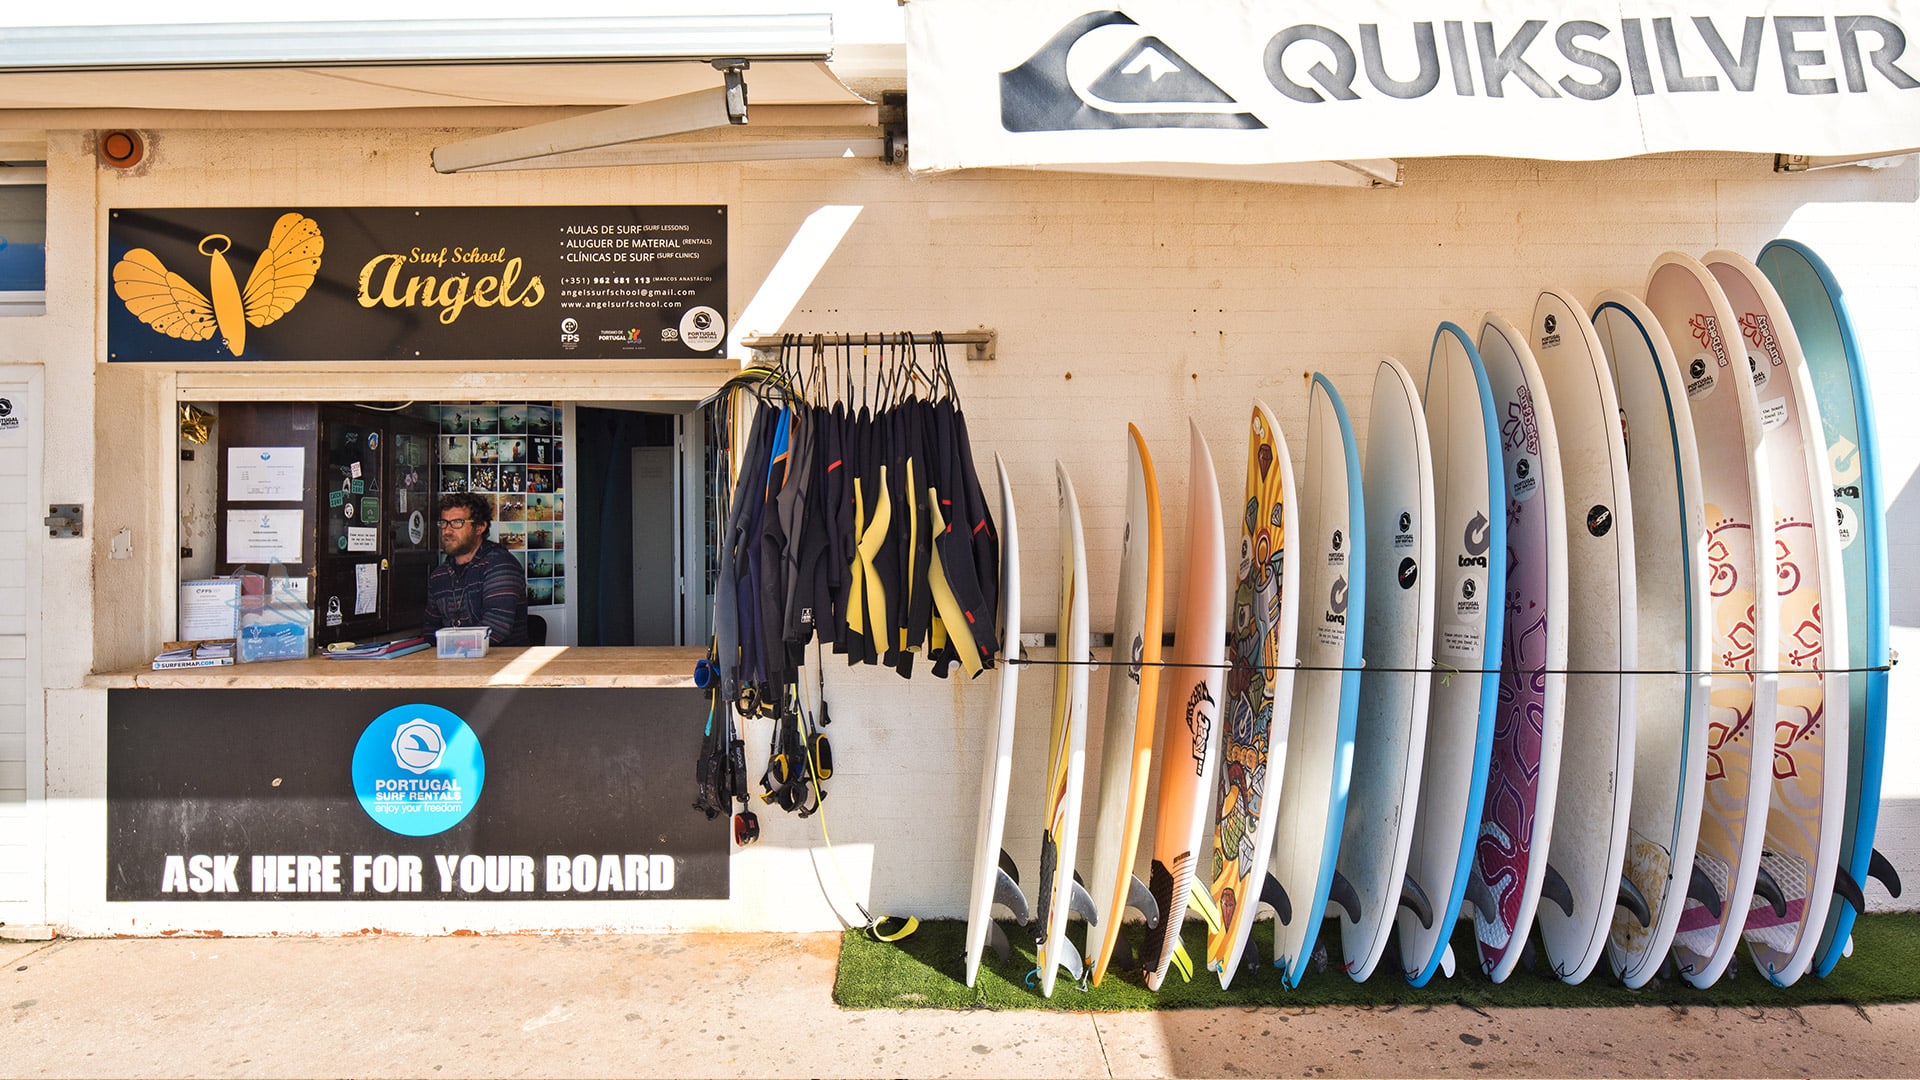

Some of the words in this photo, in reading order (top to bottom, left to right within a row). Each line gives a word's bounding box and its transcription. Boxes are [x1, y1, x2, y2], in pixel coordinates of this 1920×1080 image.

[1263, 16, 1920, 103] QUIKSILVER
[566, 225, 599, 234] AULAS
[601, 225, 614, 234] DE
[617, 225, 642, 234] SURF
[566, 239, 613, 249] ALUGUER
[616, 239, 629, 248] DE
[632, 239, 680, 248] MATERIAL
[409, 247, 447, 268] Surf
[451, 247, 506, 263] School
[566, 251, 611, 262] CLÍNICAS
[614, 253, 627, 262] DE
[629, 252, 655, 262] SURF
[561, 277, 590, 285] (+351)
[561, 289, 696, 297] angelssurfschool@gmail.com
[561, 301, 681, 309] www.angelsurfschool.com
[561, 334, 580, 342] FPS
[1458, 554, 1487, 568] torq
[1326, 610, 1345, 626] torq
[375, 779, 462, 791] PORTUGAL
[375, 791, 406, 801] SURF
[409, 791, 462, 801] RENTALS
[375, 804, 400, 815] enjoy
[401, 804, 422, 814] your
[424, 803, 462, 813] freedom
[161, 855, 239, 893] ASK
[251, 855, 341, 893] HERE
[353, 855, 423, 893] FOR
[433, 855, 535, 893] YOUR
[545, 855, 675, 892] BOARD
